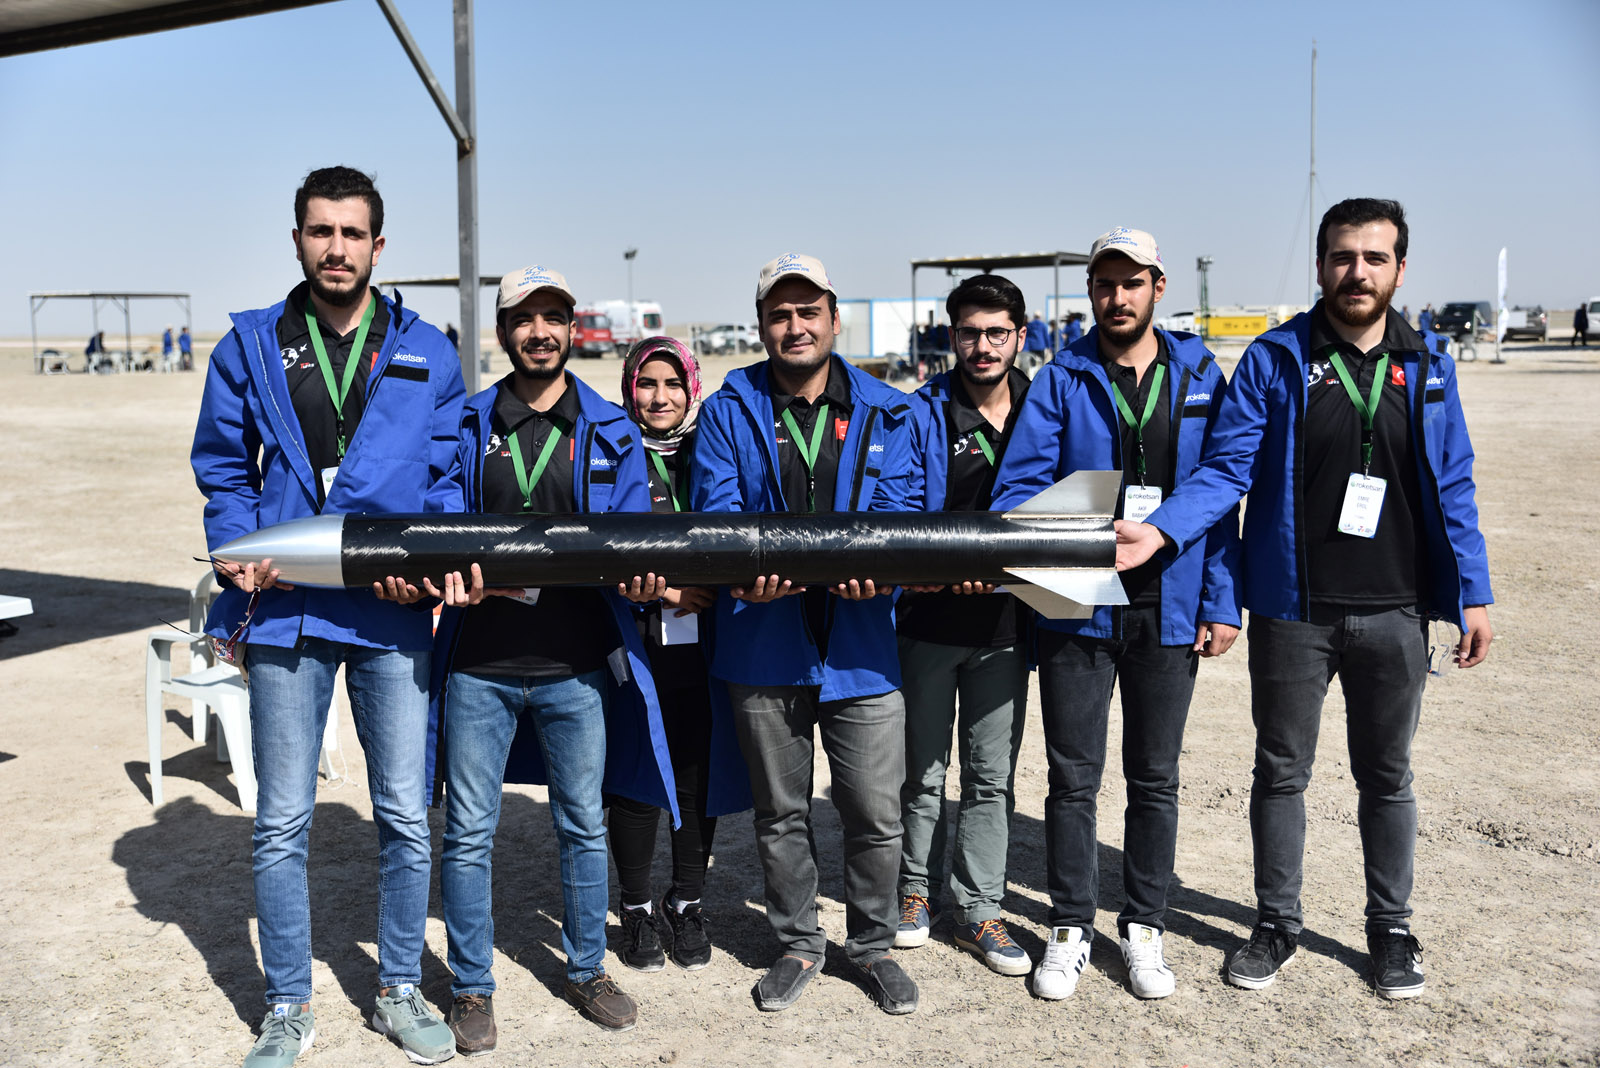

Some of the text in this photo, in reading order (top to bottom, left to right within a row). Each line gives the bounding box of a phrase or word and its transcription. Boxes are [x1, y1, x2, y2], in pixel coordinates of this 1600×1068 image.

[392, 353, 427, 364] oketsan
[1185, 392, 1211, 403] roketsa
[590, 457, 618, 466] oketsa
[1356, 482, 1383, 492] roketsan
[1389, 927, 1407, 936] adidas
